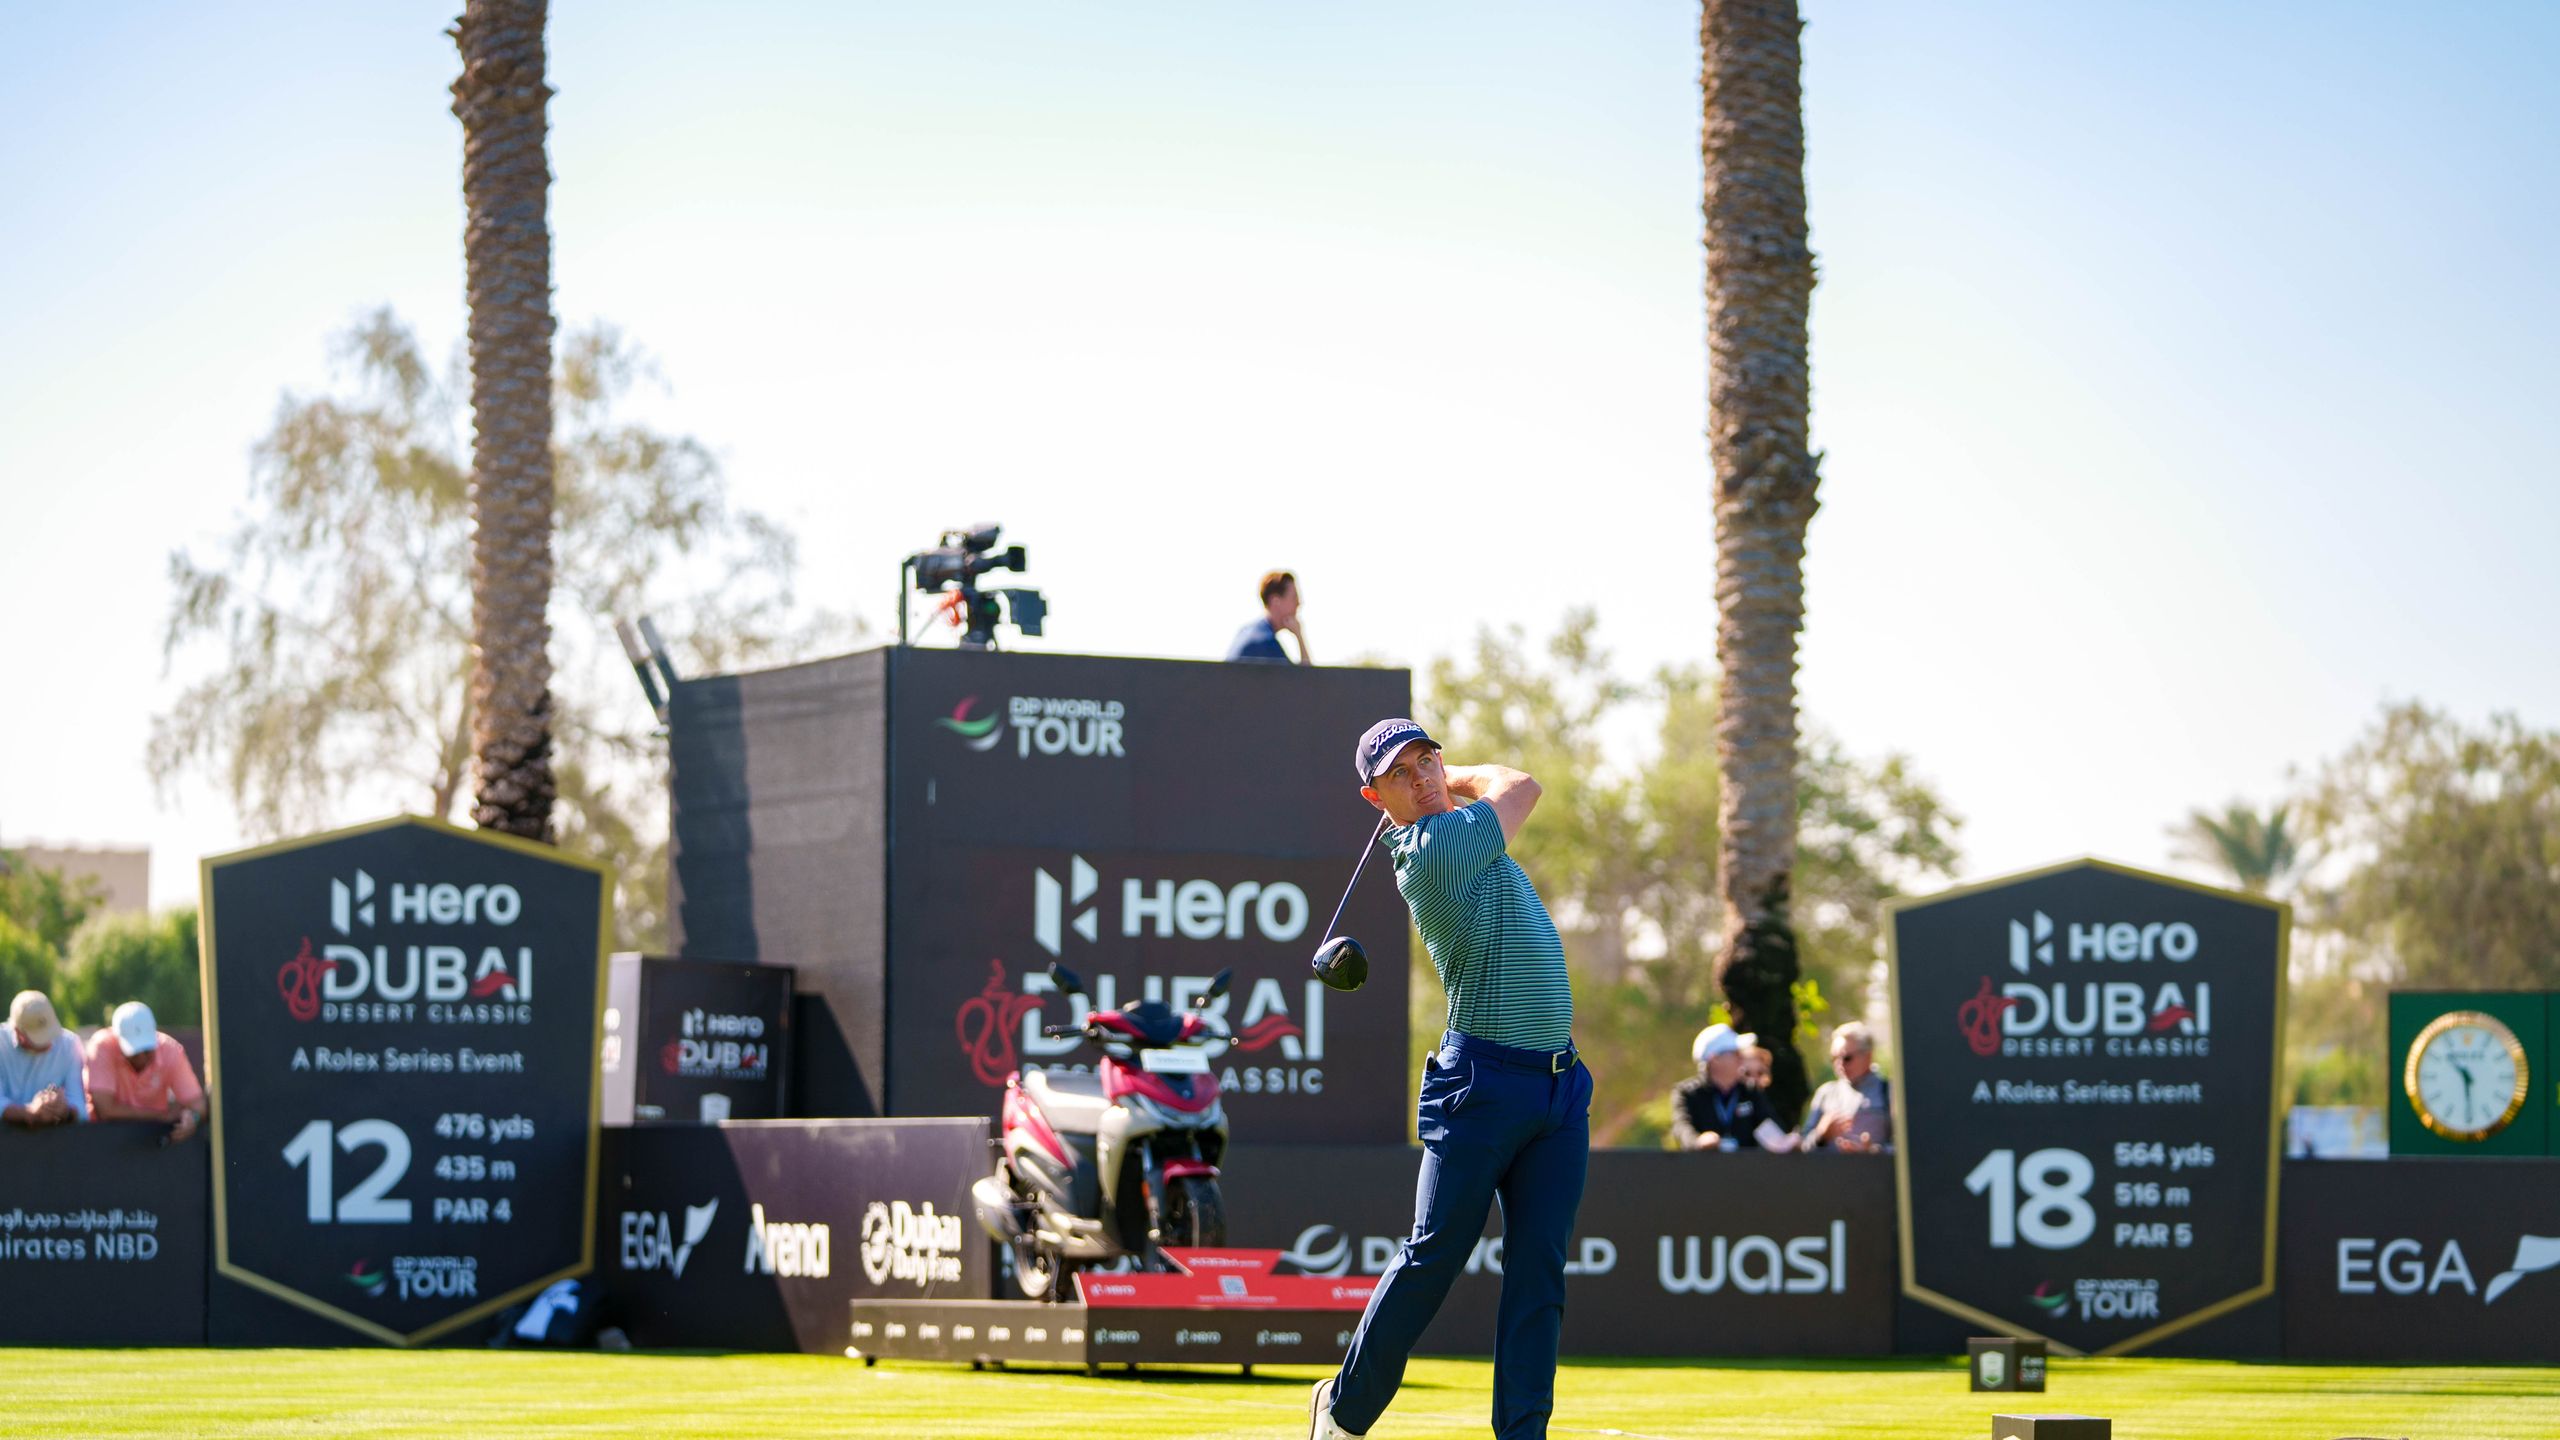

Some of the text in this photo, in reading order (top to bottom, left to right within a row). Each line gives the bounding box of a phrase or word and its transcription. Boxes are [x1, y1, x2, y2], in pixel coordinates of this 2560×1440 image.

[1009, 697, 1125, 720] DP WORLD
[1010, 716, 1126, 758] TOUR
[1370, 723, 1421, 755] Titleist
[391, 883, 521, 925] Hero
[1121, 878, 1309, 941] Hero
[2067, 922, 2198, 962] Hero
[322, 944, 532, 1002] DUBAI
[323, 1003, 532, 1024] DESERT CLASSIC
[2001, 982, 2210, 1036] DUBAI
[292, 1048, 523, 1072] A Rolex Series Event
[678, 1038, 768, 1070] DUBAI
[2002, 1038, 2210, 1057] DESERT CLASSIC
[1220, 1066, 1323, 1094] ASSIC
[1973, 1081, 2203, 1103] A Rolex Series Event
[435, 1113, 534, 1144] 476 yds
[282, 1118, 413, 1225] 12
[434, 1155, 516, 1180] 435 m
[2115, 1142, 2214, 1171] 564 yds
[435, 1198, 511, 1222] PAR 4
[1964, 1147, 2096, 1250] 18
[2115, 1183, 2190, 1207] 516 m
[621, 1211, 674, 1271] EGA
[744, 1203, 830, 1278] Arena
[891, 1201, 961, 1251] Dubai
[2115, 1224, 2192, 1247] PAR 5
[0, 1233, 158, 1261] irates NBD
[1658, 1220, 1846, 1294] wasl
[2337, 1238, 2477, 1294] EGA
[394, 1270, 478, 1300] TOUR
[2076, 1291, 2160, 1321] TOUR
